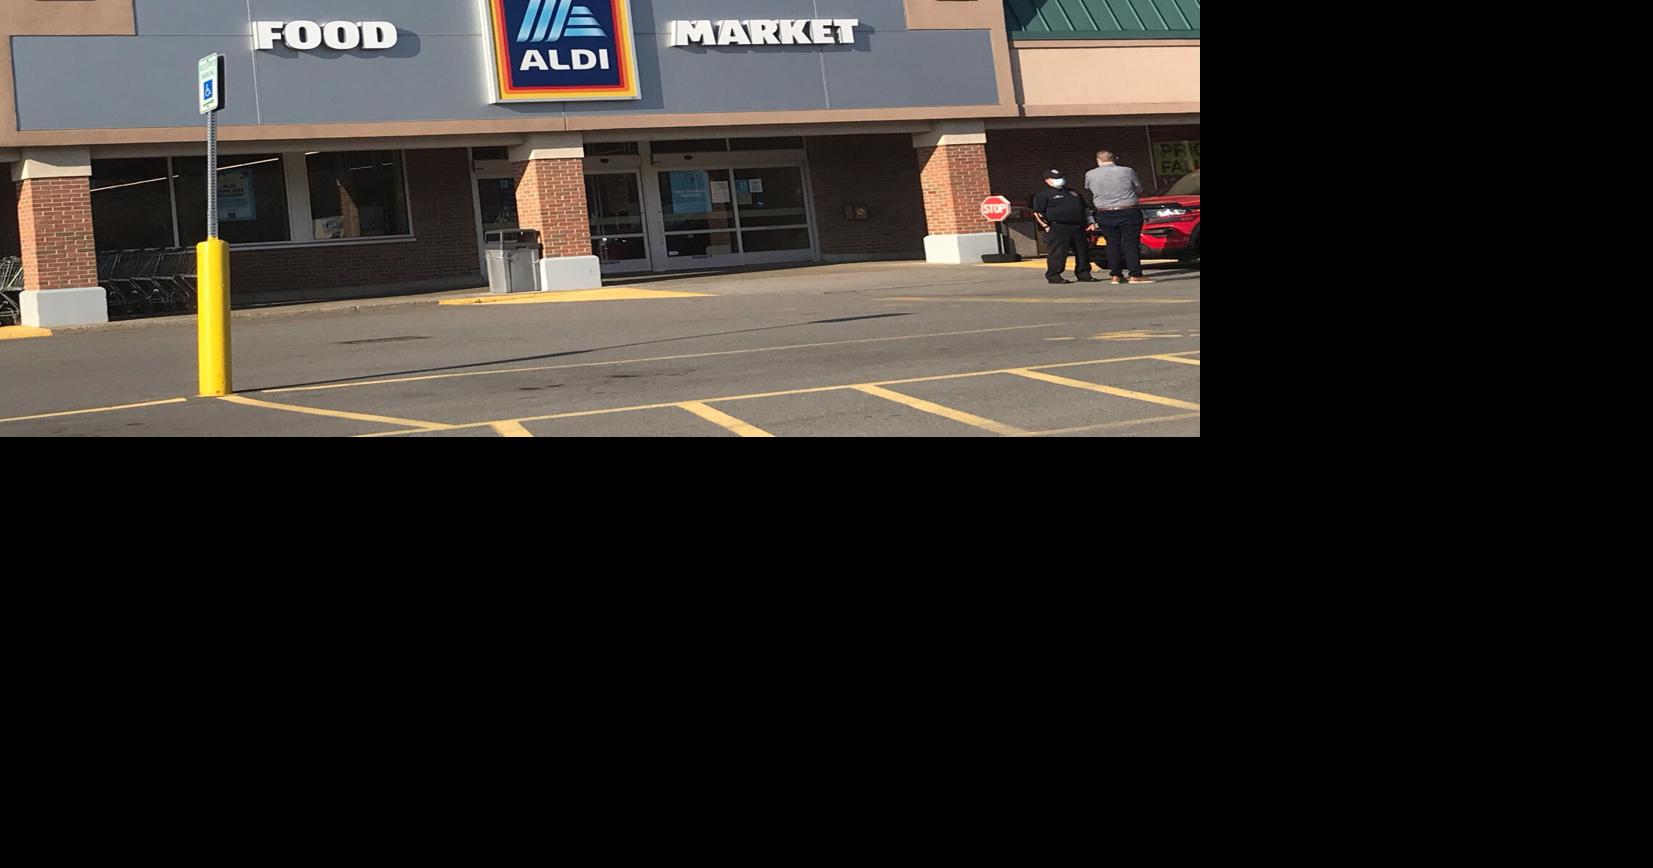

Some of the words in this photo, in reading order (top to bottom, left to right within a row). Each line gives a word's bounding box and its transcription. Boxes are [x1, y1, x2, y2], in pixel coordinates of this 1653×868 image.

[252, 20, 398, 50] FOOD
[671, 18, 859, 46] MARKET
[519, 48, 610, 71] ALDI
[983, 203, 1006, 214] STOP
